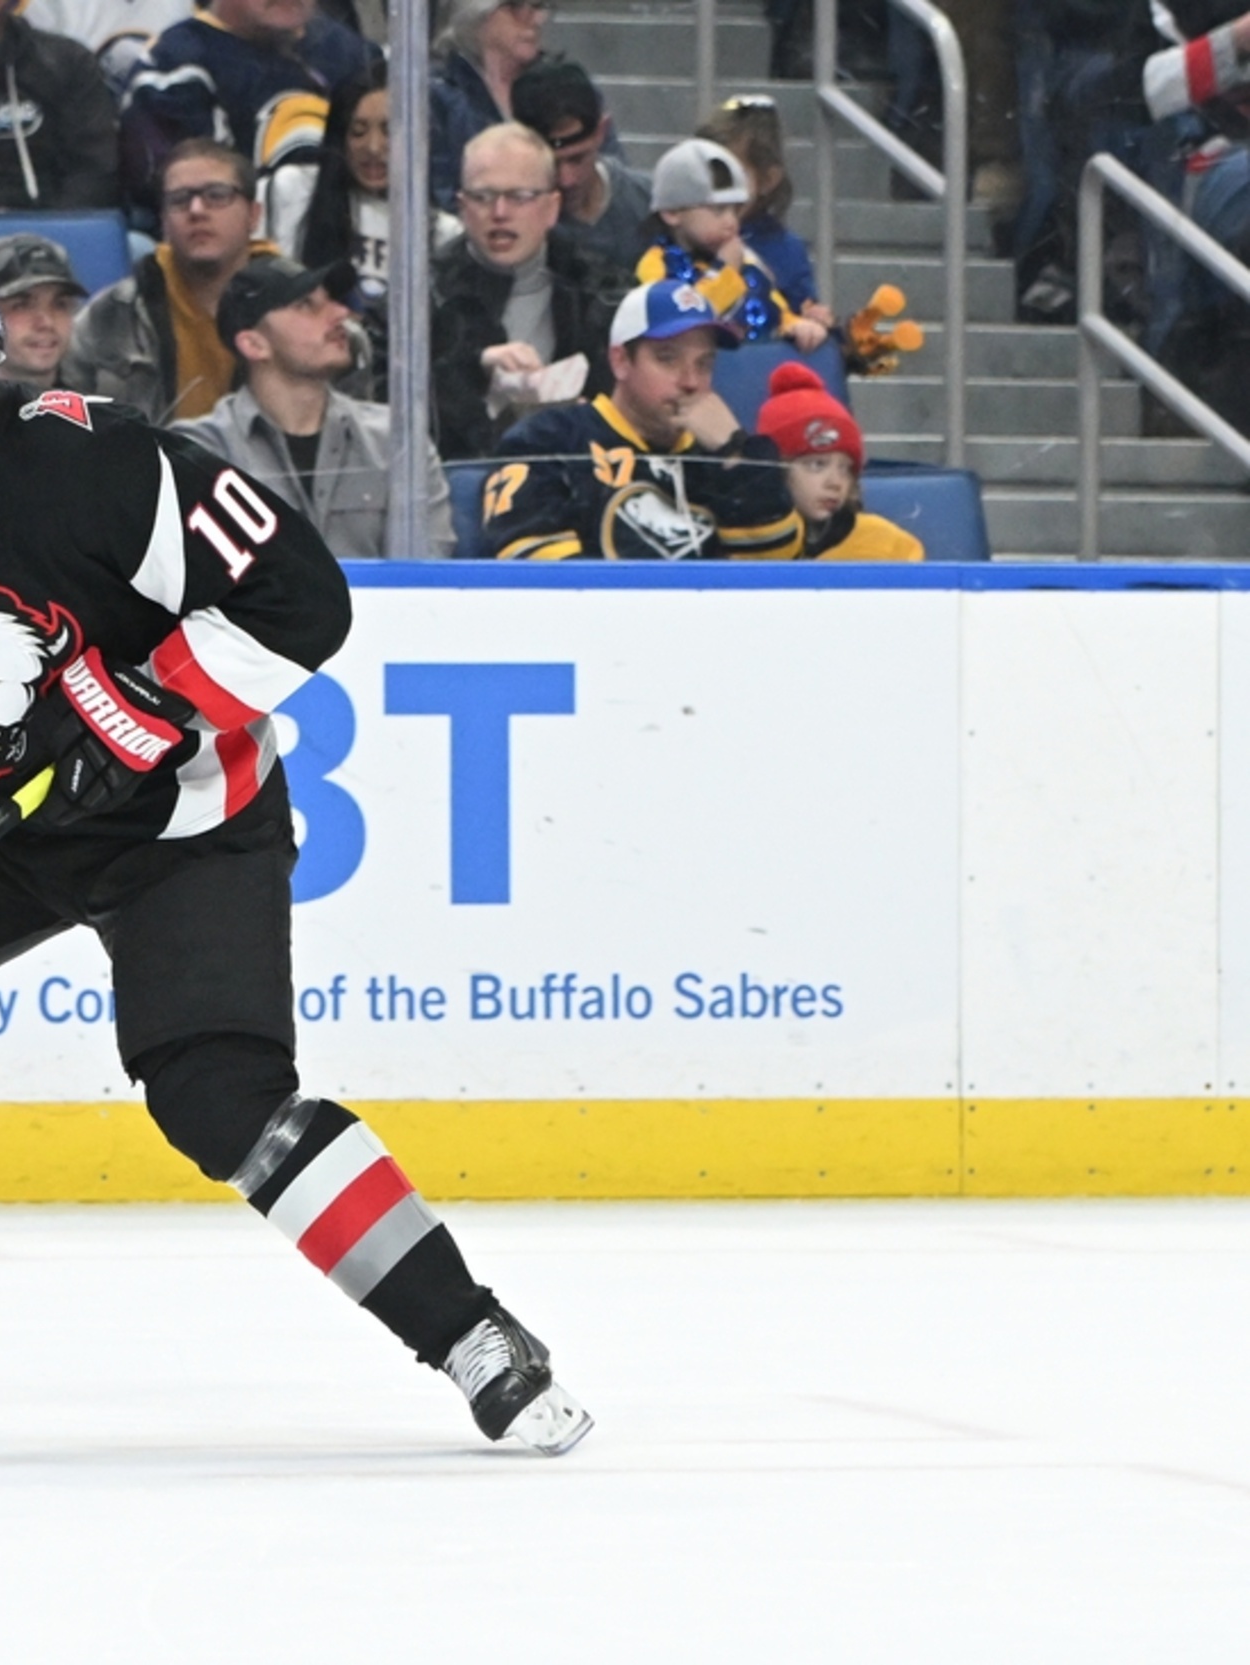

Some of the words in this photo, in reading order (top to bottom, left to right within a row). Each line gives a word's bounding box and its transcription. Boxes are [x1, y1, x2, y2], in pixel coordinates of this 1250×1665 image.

[186, 467, 279, 584] 10
[62, 654, 173, 764] WARRIOR
[298, 974, 347, 1022] of
[365, 974, 447, 1022] the
[469, 972, 653, 1021] Buffalo
[673, 972, 845, 1020] Sabres
